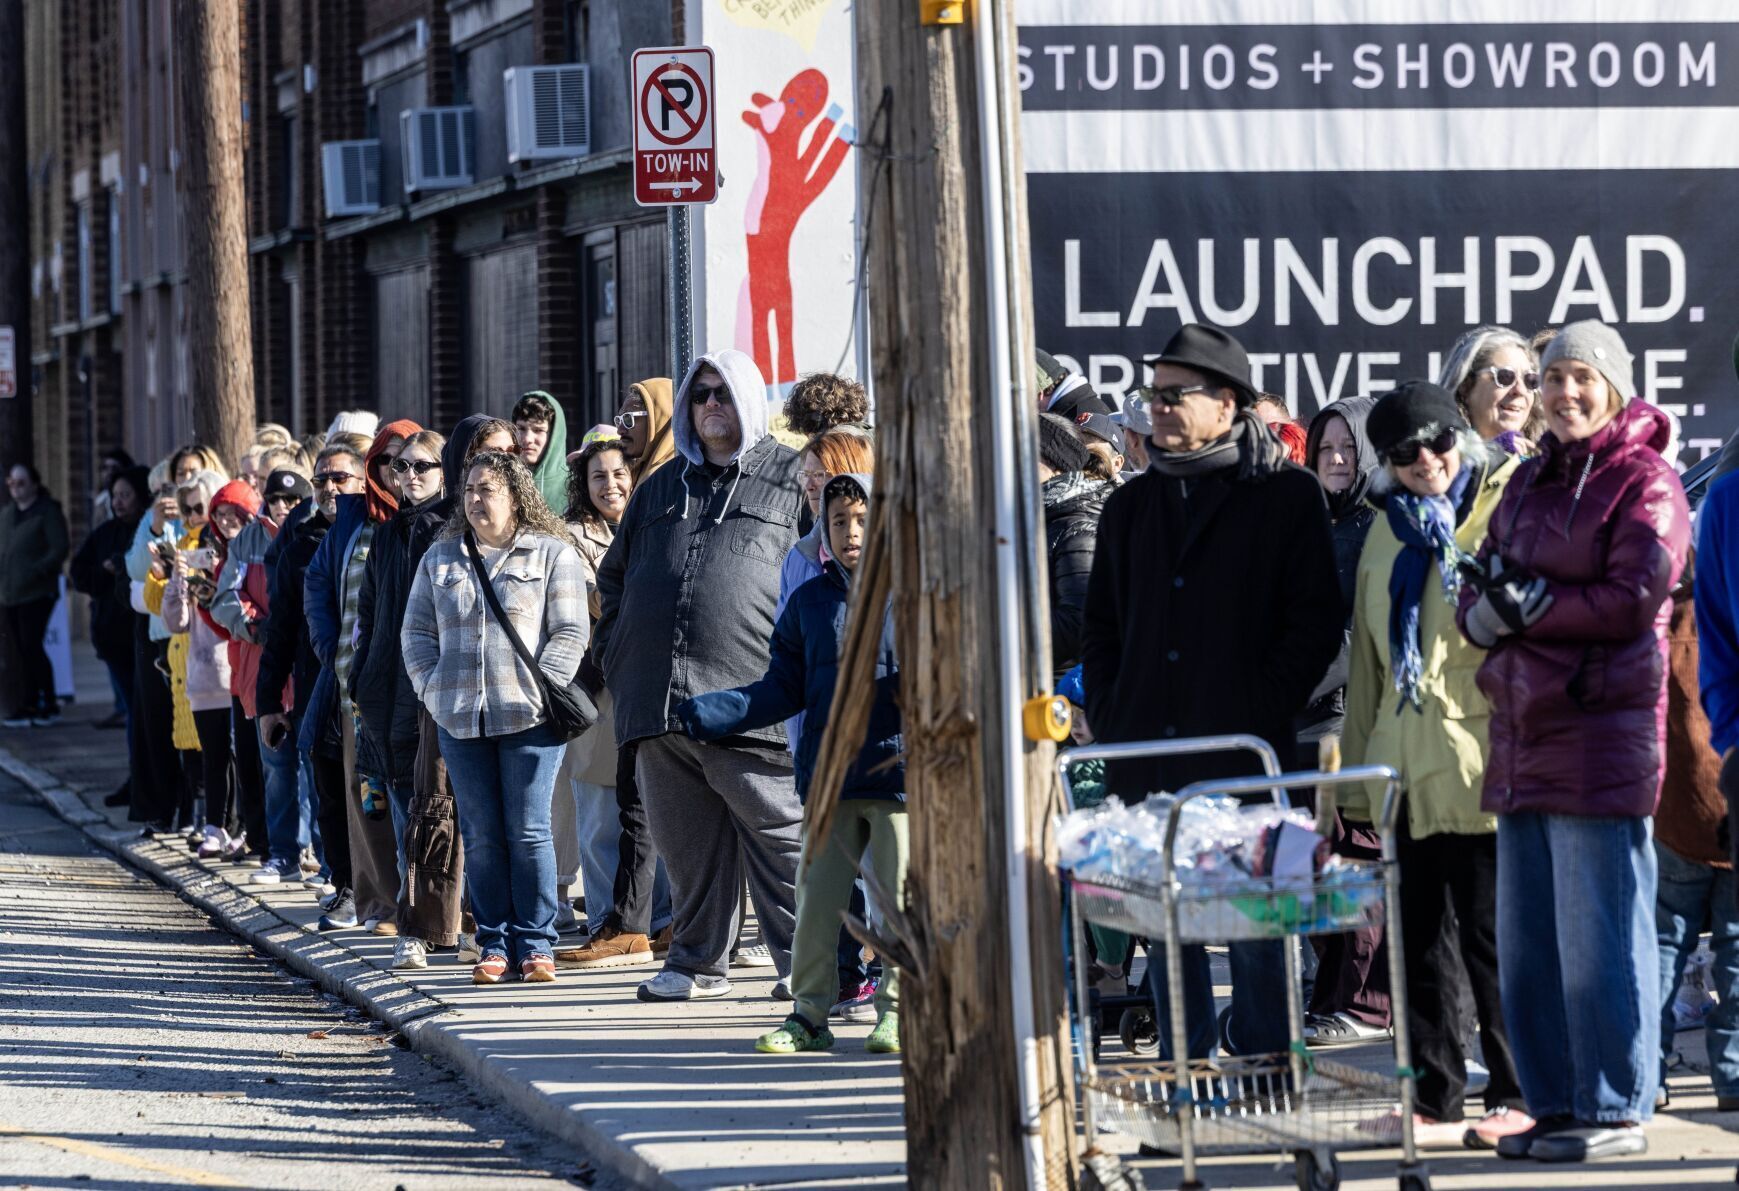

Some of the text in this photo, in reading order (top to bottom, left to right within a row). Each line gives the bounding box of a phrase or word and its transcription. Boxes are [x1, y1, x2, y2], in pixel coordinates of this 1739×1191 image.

[1017, 44, 1280, 91] STUDIOS
[1352, 42, 1717, 90] SHOWROOM
[643, 152, 709, 173] TOW-IN
[1064, 235, 1705, 328] LAUNCHPAD.
